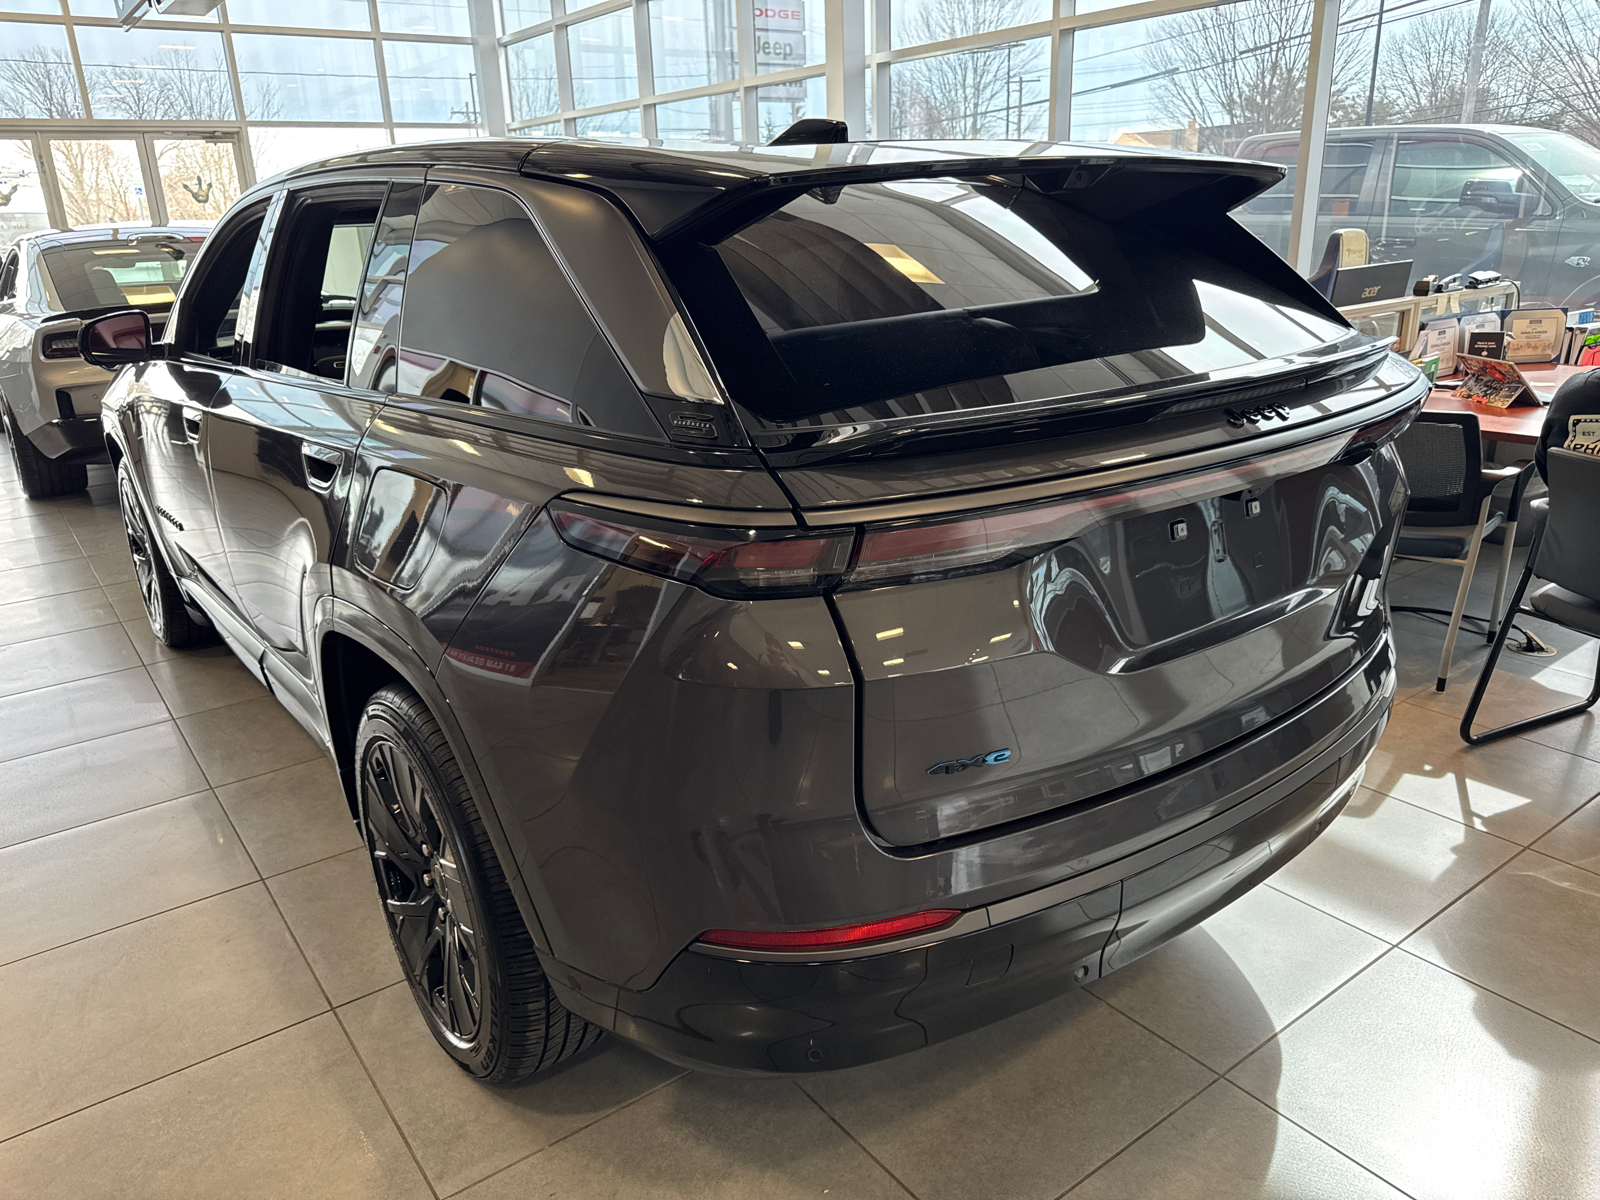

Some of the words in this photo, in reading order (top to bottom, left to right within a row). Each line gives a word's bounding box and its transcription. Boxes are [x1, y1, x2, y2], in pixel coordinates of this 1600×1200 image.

[754, 8, 802, 20] ODGE
[756, 35, 793, 60] Jeep
[1361, 286, 1381, 298] acer
[1222, 402, 1290, 429] Jeep
[1572, 443, 1600, 455] PH
